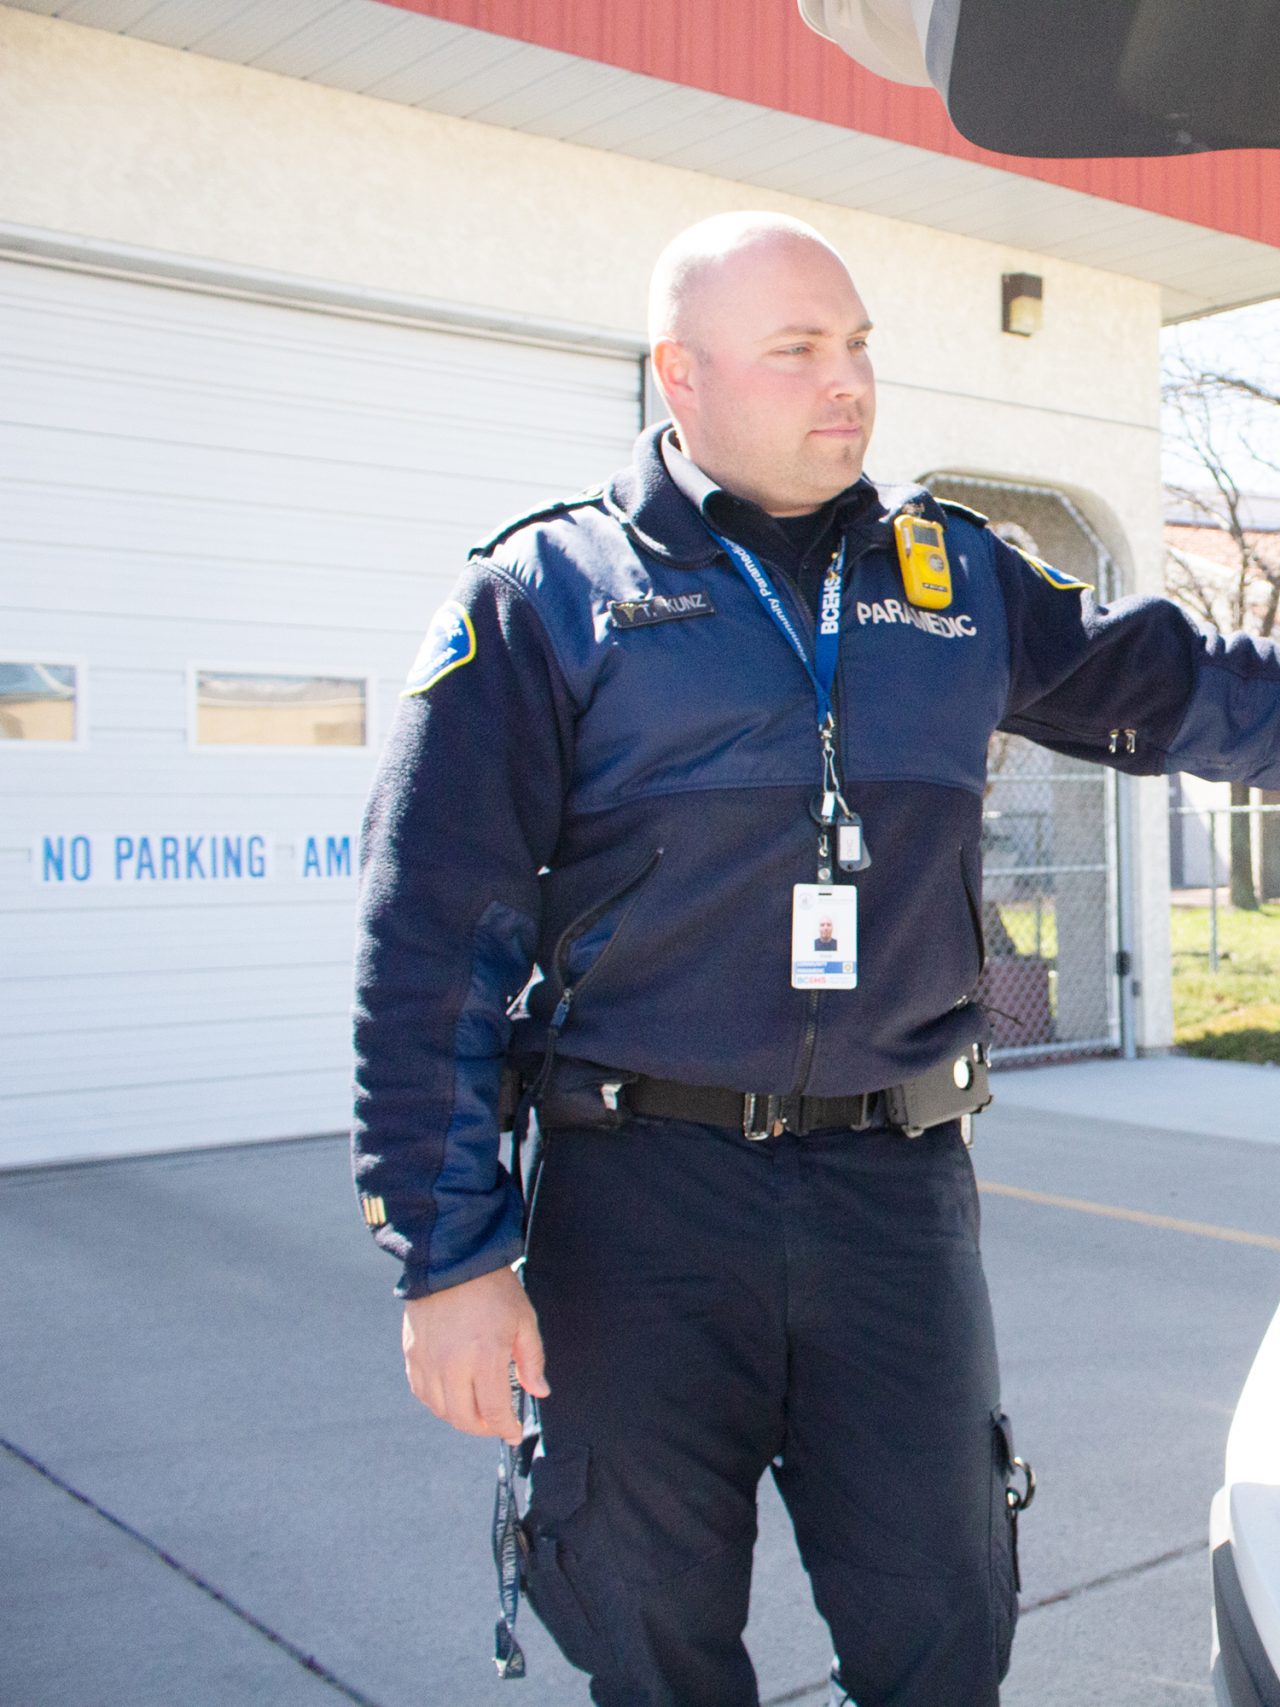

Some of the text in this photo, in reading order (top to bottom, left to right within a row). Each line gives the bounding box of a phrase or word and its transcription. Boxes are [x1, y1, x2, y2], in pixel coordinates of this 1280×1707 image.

[663, 594, 707, 613] KUNZ
[820, 576, 841, 635] BCEHS
[857, 598, 977, 638] PARAMEDIC
[42, 835, 351, 882] NO PARKING AM
